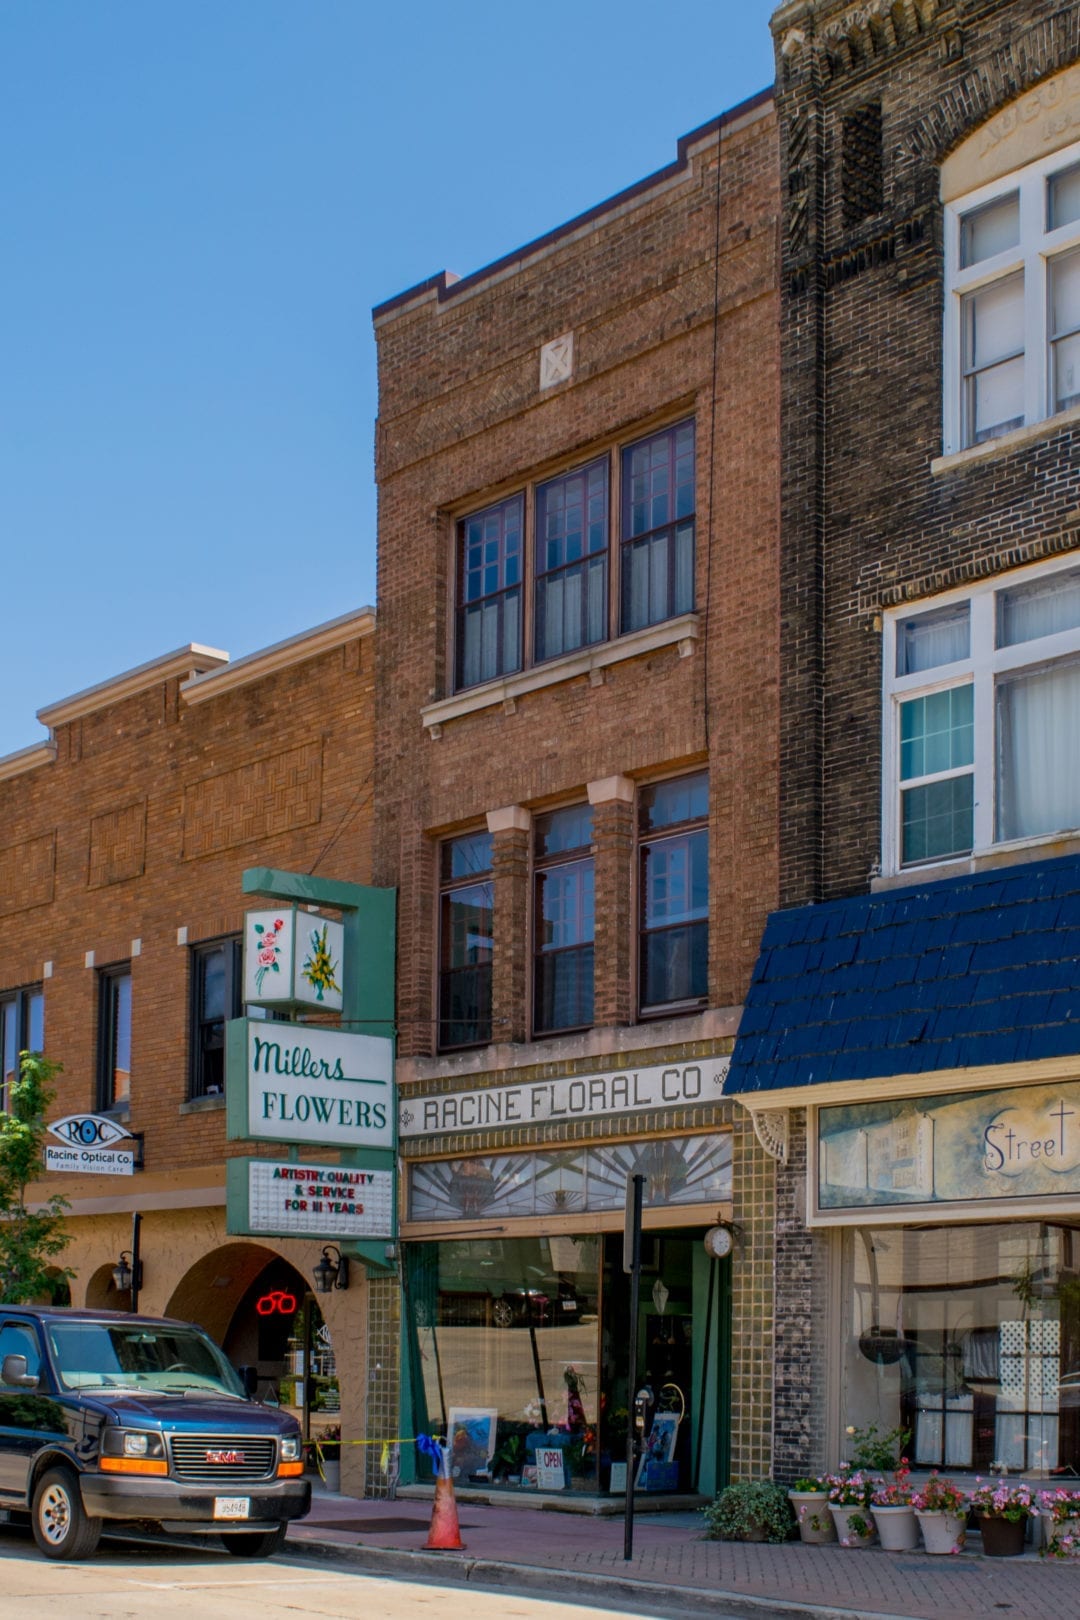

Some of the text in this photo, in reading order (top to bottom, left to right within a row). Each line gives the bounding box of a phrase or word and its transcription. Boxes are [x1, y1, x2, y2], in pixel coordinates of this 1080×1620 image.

[254, 1036, 386, 1085] Millers
[423, 1065, 701, 1130] RACINE FLORAL CO
[262, 1091, 387, 1129] FLOWERS
[68, 1119, 111, 1144] ROC
[47, 1150, 132, 1164] Racine Optical Co.
[273, 1167, 375, 1185] ARTISTRY QUALITY
[308, 1185, 355, 1199] SERVICE
[285, 1199, 308, 1211] FOR
[328, 1201, 364, 1215] YEARS
[206, 1450, 245, 1463] GMC
[544, 1452, 562, 1467] OPEN
